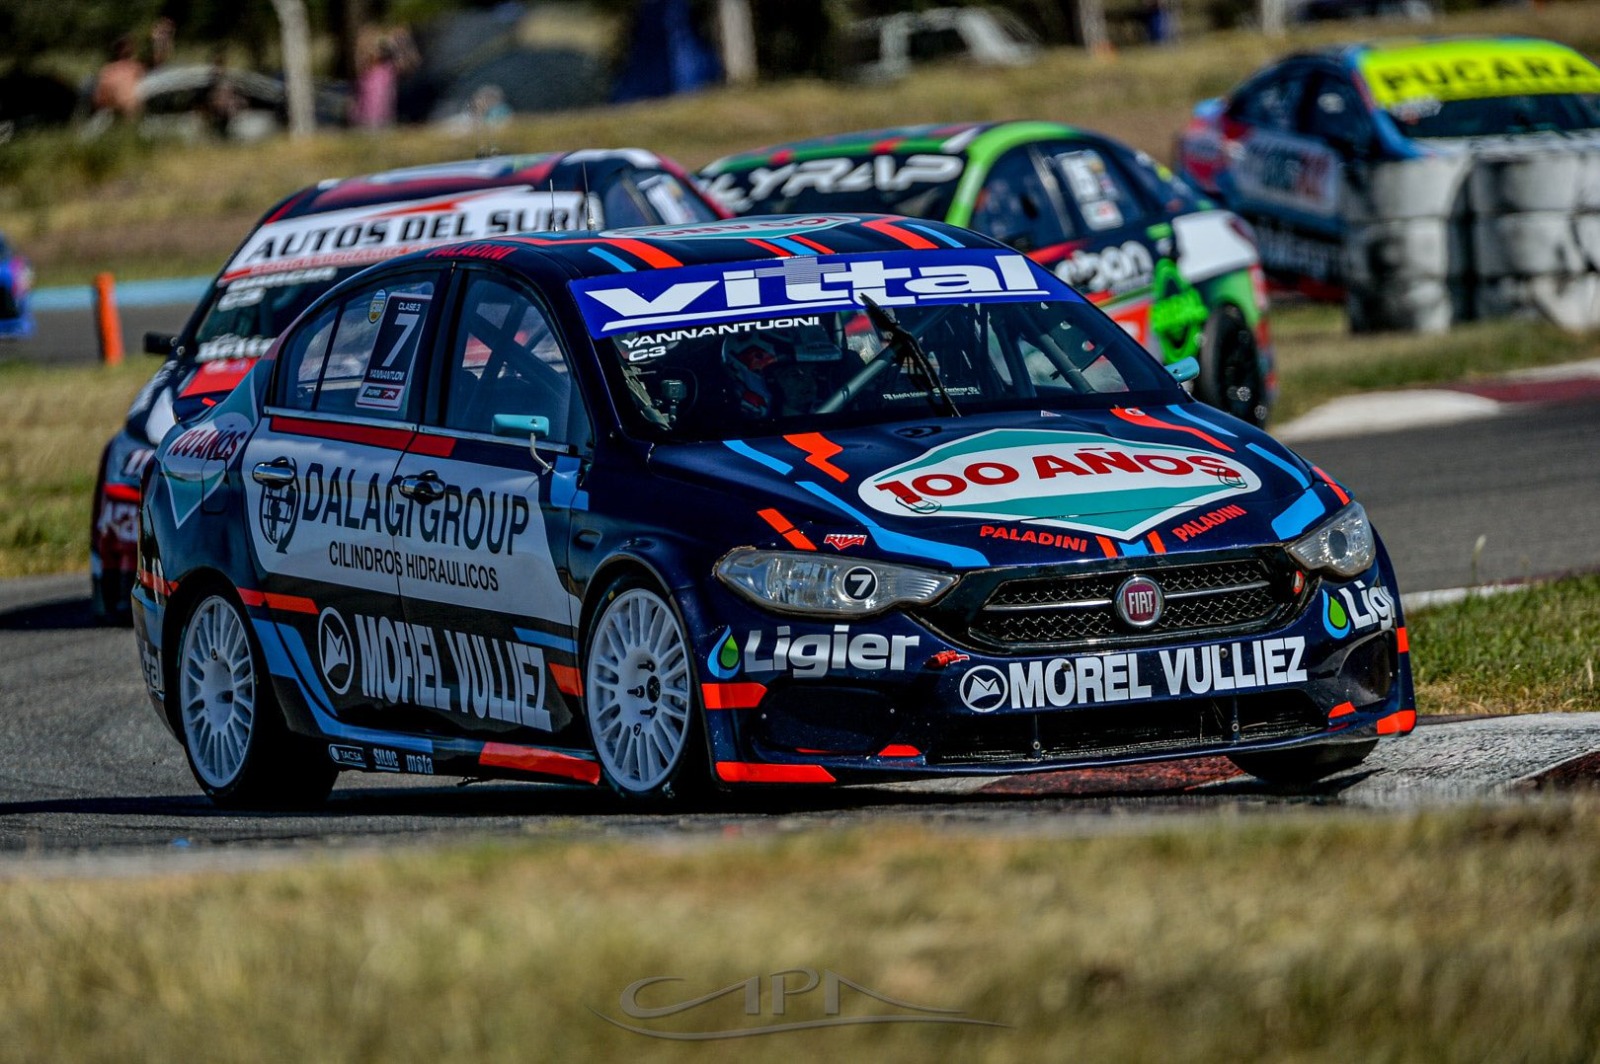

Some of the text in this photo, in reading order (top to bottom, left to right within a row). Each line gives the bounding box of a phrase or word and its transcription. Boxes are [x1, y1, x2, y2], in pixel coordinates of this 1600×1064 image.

[244, 220, 389, 264] AUTOS
[401, 212, 474, 241] DEL
[485, 205, 570, 233] SUR
[584, 255, 1038, 317] vittal
[382, 312, 420, 367] 7
[621, 316, 819, 349] YANNANTUONI
[629, 345, 667, 362] C3
[167, 424, 247, 461] 100 AÑOS
[302, 462, 413, 538] DALAGI
[875, 448, 1242, 505] 100 AÑOS
[824, 534, 867, 550] RIVA
[980, 504, 1247, 552] PALADINI PALADINI
[329, 540, 499, 592] CILINDROS HIDRAULICOS
[850, 574, 872, 597] 7
[1128, 590, 1153, 615] FIAT
[354, 613, 553, 733] MOREL VULLIEZ
[744, 624, 920, 678] Ligier
[1009, 636, 1308, 709] MOREL VULLIEZ
